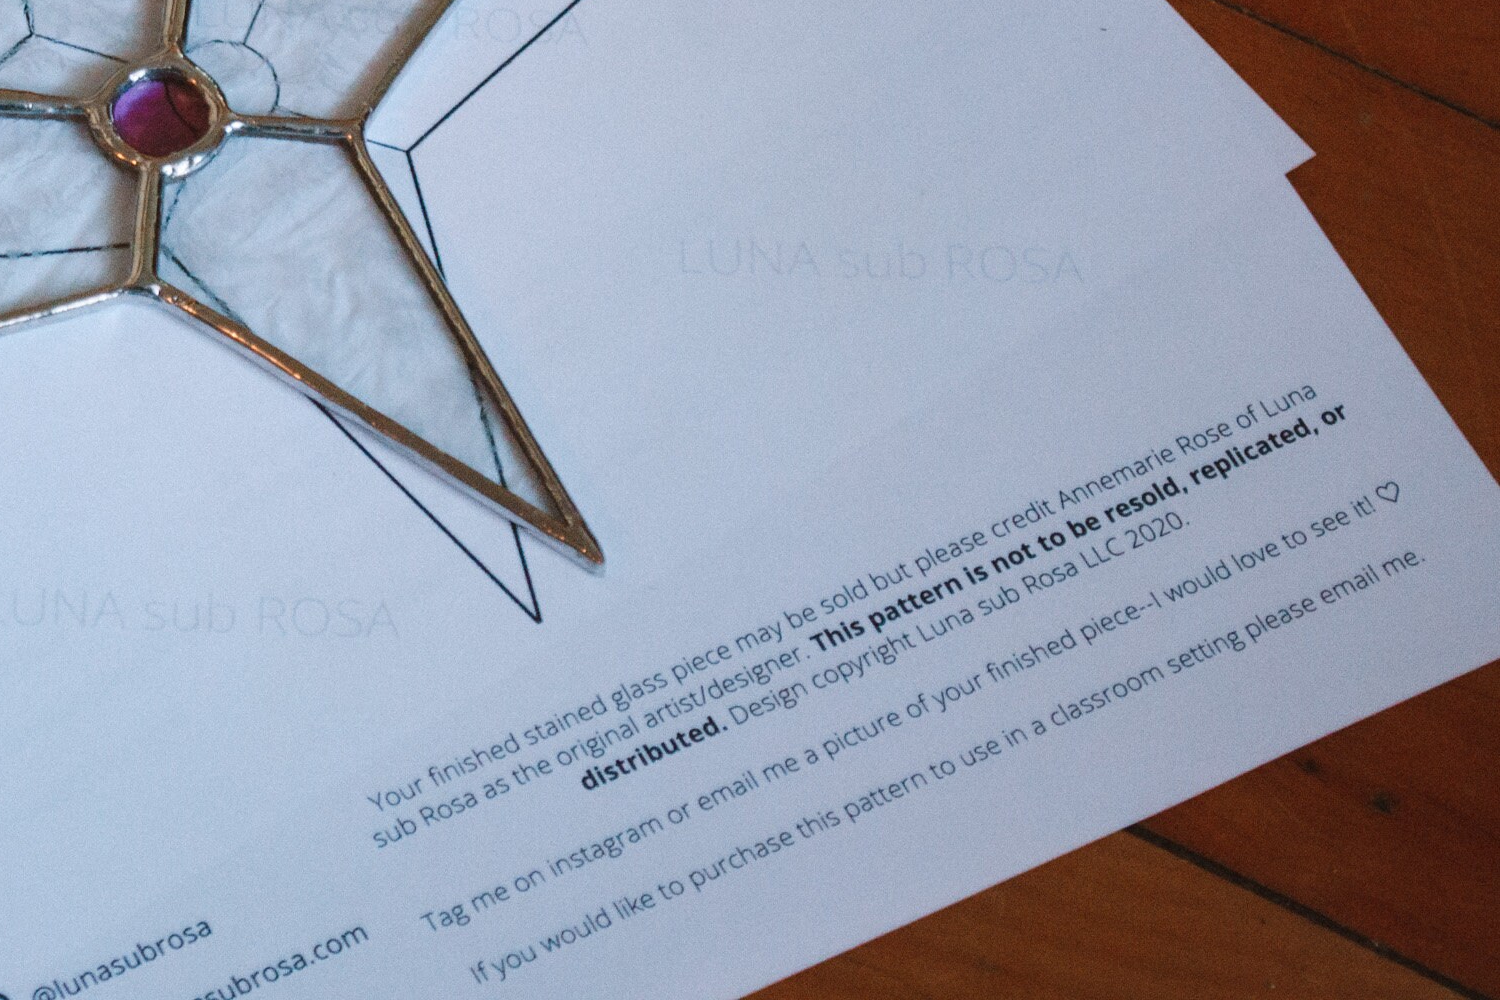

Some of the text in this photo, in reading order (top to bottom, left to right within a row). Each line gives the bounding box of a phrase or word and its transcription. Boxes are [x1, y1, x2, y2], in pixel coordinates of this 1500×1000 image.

[678, 236, 1086, 285] LUNA sub ROSA
[141, 588, 238, 635] sub
[257, 593, 400, 639] ROSA
[365, 383, 1317, 812] Your finished stained glass piece may be sold but please credit Annemarie Rose of Luna
[371, 402, 1346, 849] sub Rosa as the original artist/designer. This pattern is not to be resold, replicated, or
[418, 494, 1376, 932] Tag me on instagram or email me a picture of your finished piece--I would love to see it!
[468, 549, 1426, 984] If you would like to purchase this pattern to use in a classroom setting please email me.
[579, 510, 1190, 791] distributed. Design copyright Luna sub Rosa LLC 2020.
[31, 919, 214, 1000] @lunasubrosa
